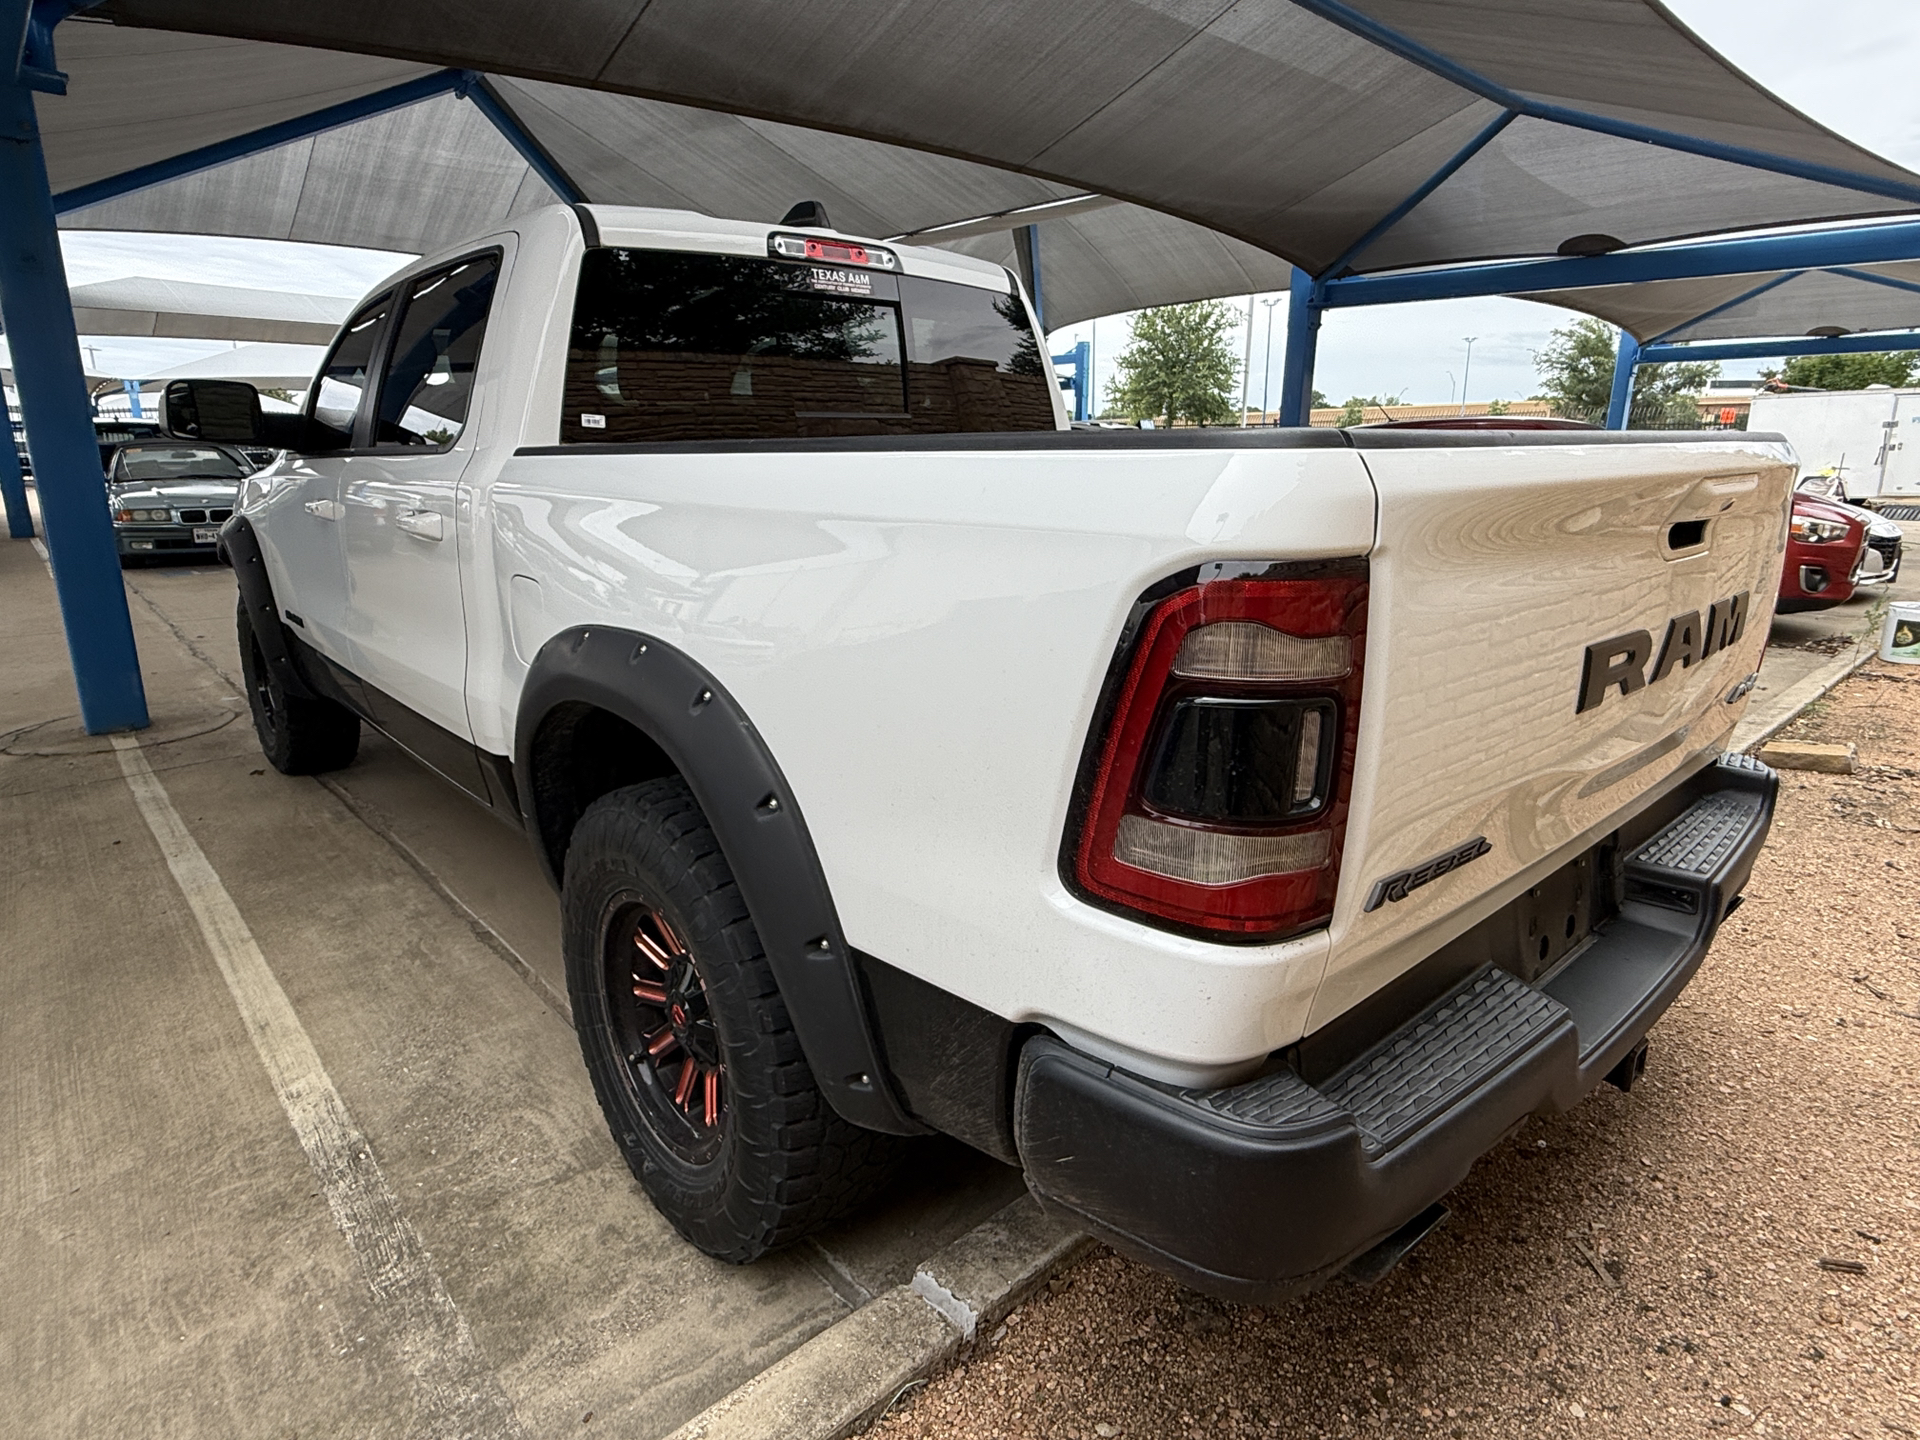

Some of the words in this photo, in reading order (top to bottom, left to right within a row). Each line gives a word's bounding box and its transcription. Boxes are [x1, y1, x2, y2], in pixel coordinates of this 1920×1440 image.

[811, 268, 846, 283] TEXAS
[848, 272, 870, 285] A&M
[1575, 590, 1750, 714] RAM
[1363, 835, 1493, 913] REBEL
